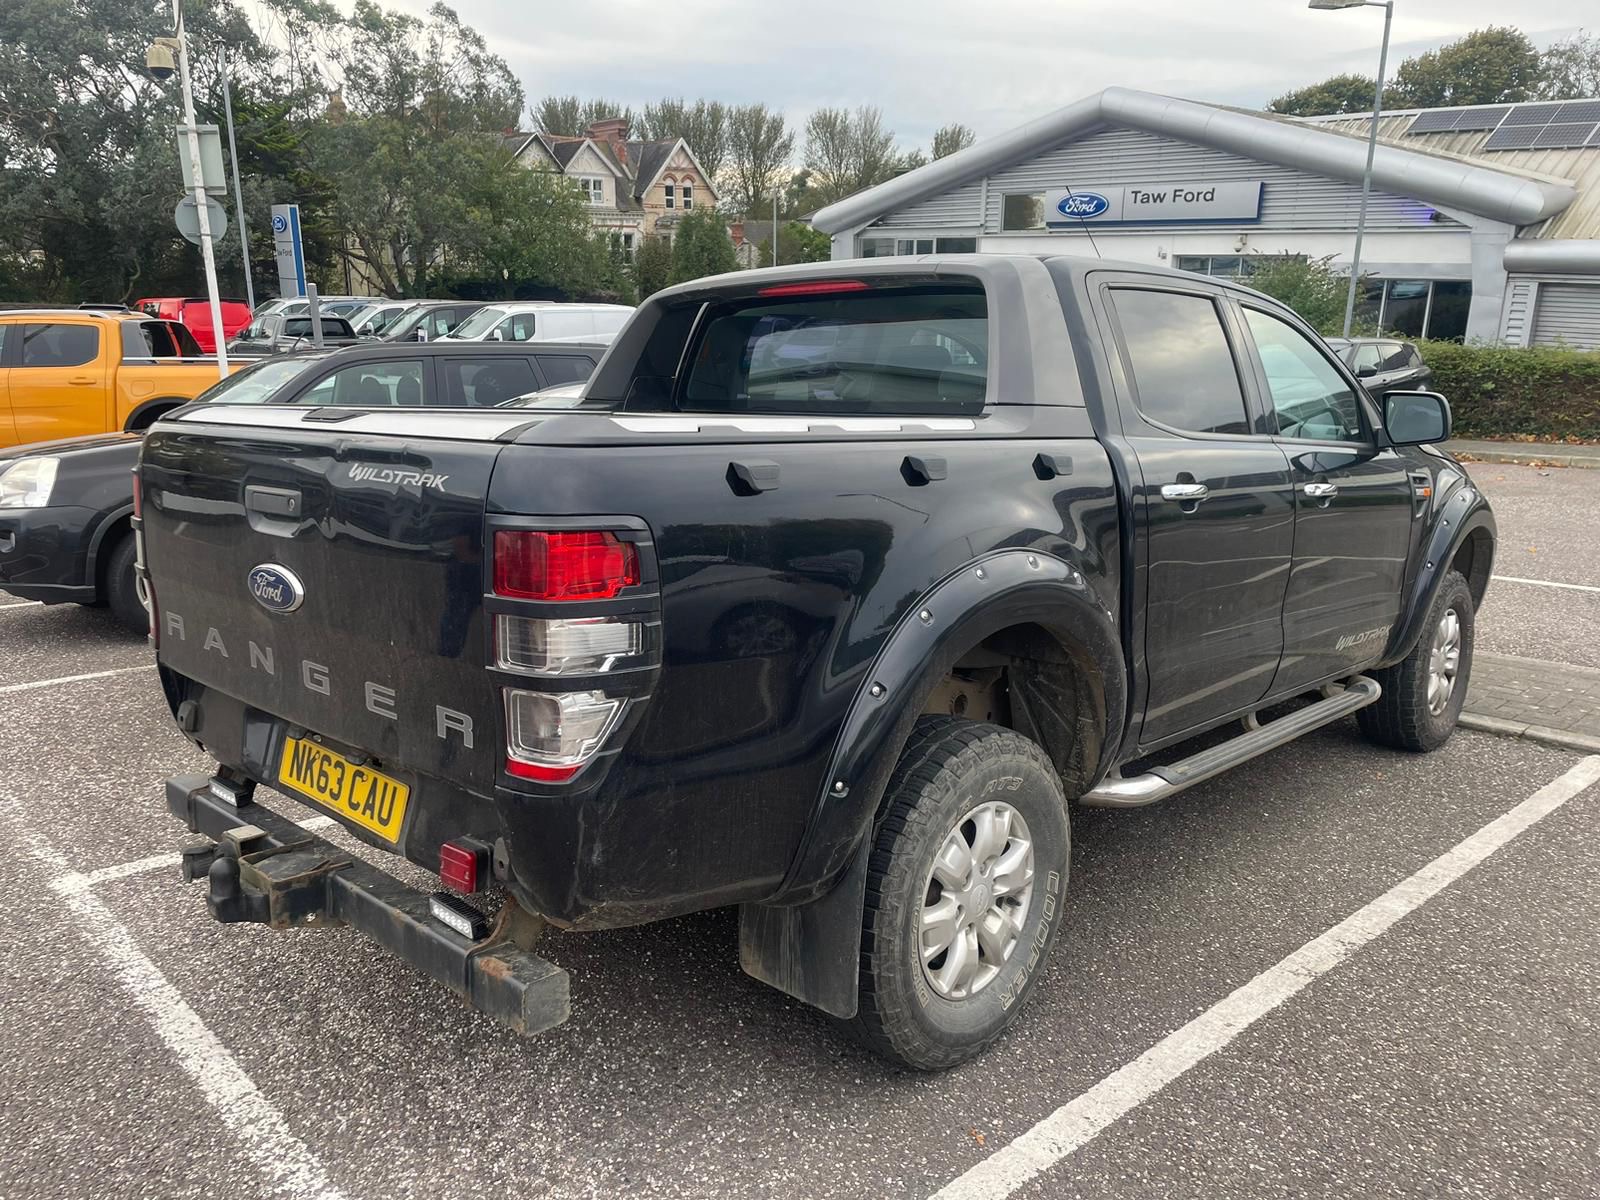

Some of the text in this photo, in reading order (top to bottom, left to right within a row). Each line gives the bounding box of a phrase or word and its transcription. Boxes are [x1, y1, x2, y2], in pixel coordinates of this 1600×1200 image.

[1065, 196, 1098, 213] Ford
[1131, 187, 1216, 204] Taw Ford
[348, 463, 450, 492] WILDTRAK
[253, 571, 284, 603] Ford
[165, 610, 474, 750] RANGER
[288, 740, 398, 827] NK63 CAU
[999, 870, 1060, 1011] COOPER
